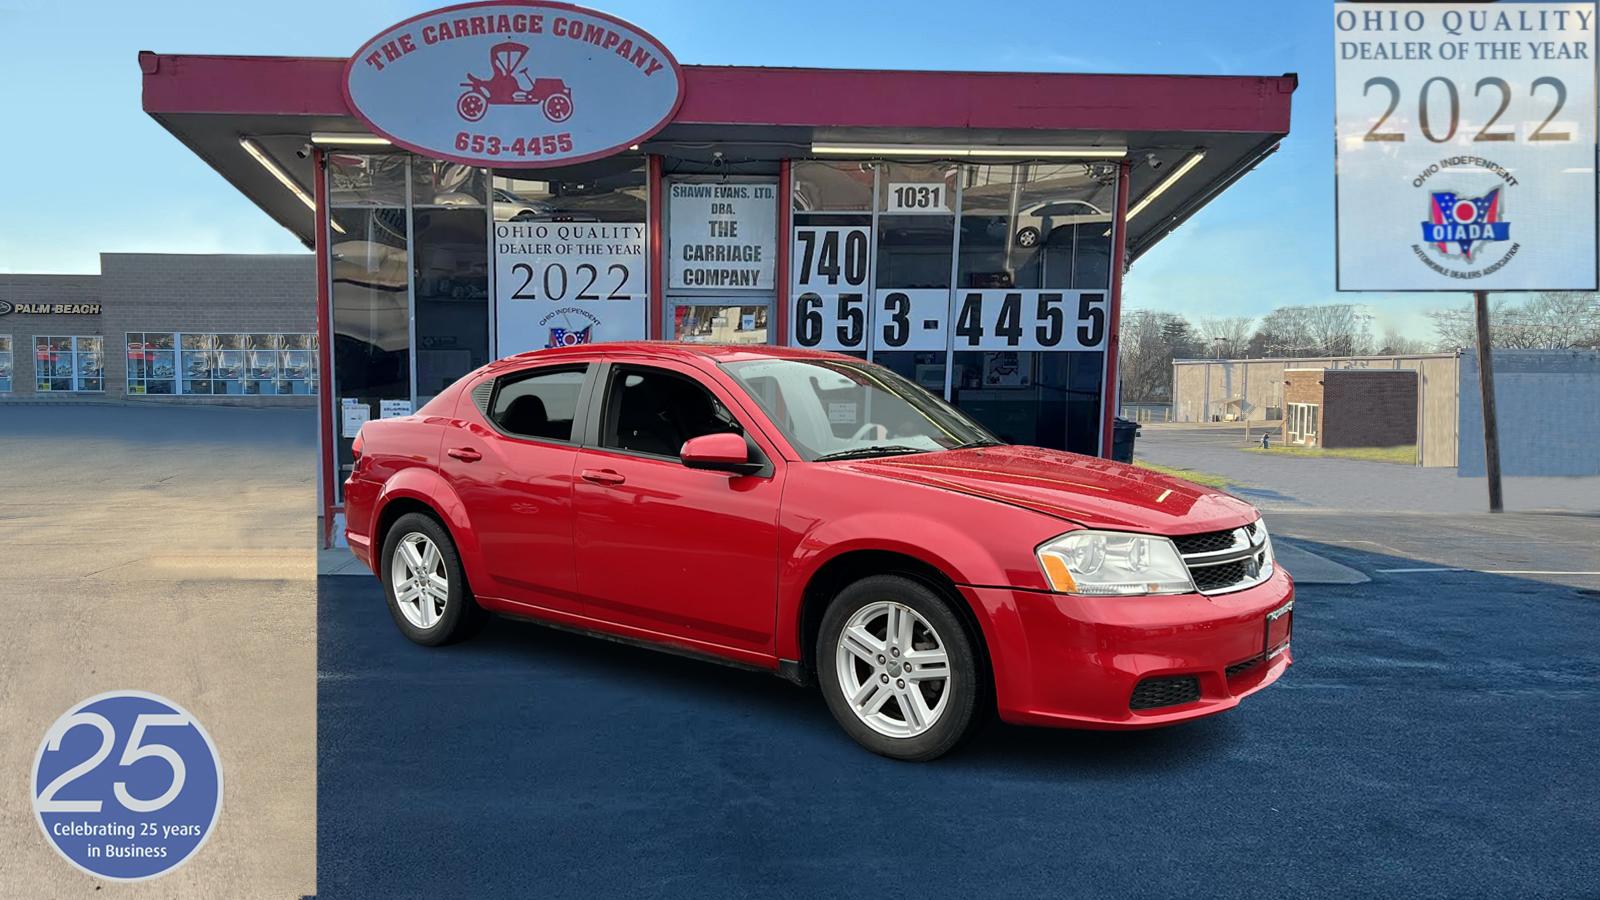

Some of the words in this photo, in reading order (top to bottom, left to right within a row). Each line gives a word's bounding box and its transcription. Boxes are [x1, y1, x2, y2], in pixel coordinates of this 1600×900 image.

[1336, 10, 1425, 31] OHIO
[1442, 10, 1592, 35] QUALITY
[366, 34, 416, 71] THE
[422, 14, 543, 45] CARRIAGE
[552, 17, 664, 77] COMPANY
[1340, 42, 1433, 60] DEALER
[1439, 42, 1469, 60] OF
[1475, 42, 1522, 60] THE
[1528, 42, 1589, 60] YEAR
[1362, 76, 1571, 143] 2022
[455, 132, 573, 156] 653-4455
[1413, 164, 1440, 188] OHIO
[1440, 156, 1519, 187] INDEPENDENT
[672, 185, 712, 199] SHAWN
[754, 187, 774, 200] LTD.
[894, 187, 940, 208] 1031
[711, 203, 735, 215] DBA.
[497, 226, 548, 240] OHIO
[558, 226, 644, 241] QUALITY
[708, 220, 737, 238] THE
[1433, 224, 1495, 240] OIADA
[499, 243, 552, 255] DEALER
[555, 244, 573, 255] OF
[576, 244, 603, 255] THE
[606, 244, 642, 255] YEAR
[683, 244, 762, 262] CARRIAGE
[797, 230, 867, 286] 740
[1411, 244, 1449, 276] AUTOMOBILE
[1450, 269, 1482, 279] DEALERS
[1482, 242, 1520, 275] ASSOCIATION
[511, 262, 632, 301] 2022
[683, 268, 760, 287] COMPANY
[15, 304, 50, 313] PALM
[539, 312, 555, 326] OHIO
[555, 307, 601, 326] INDEPENDENT
